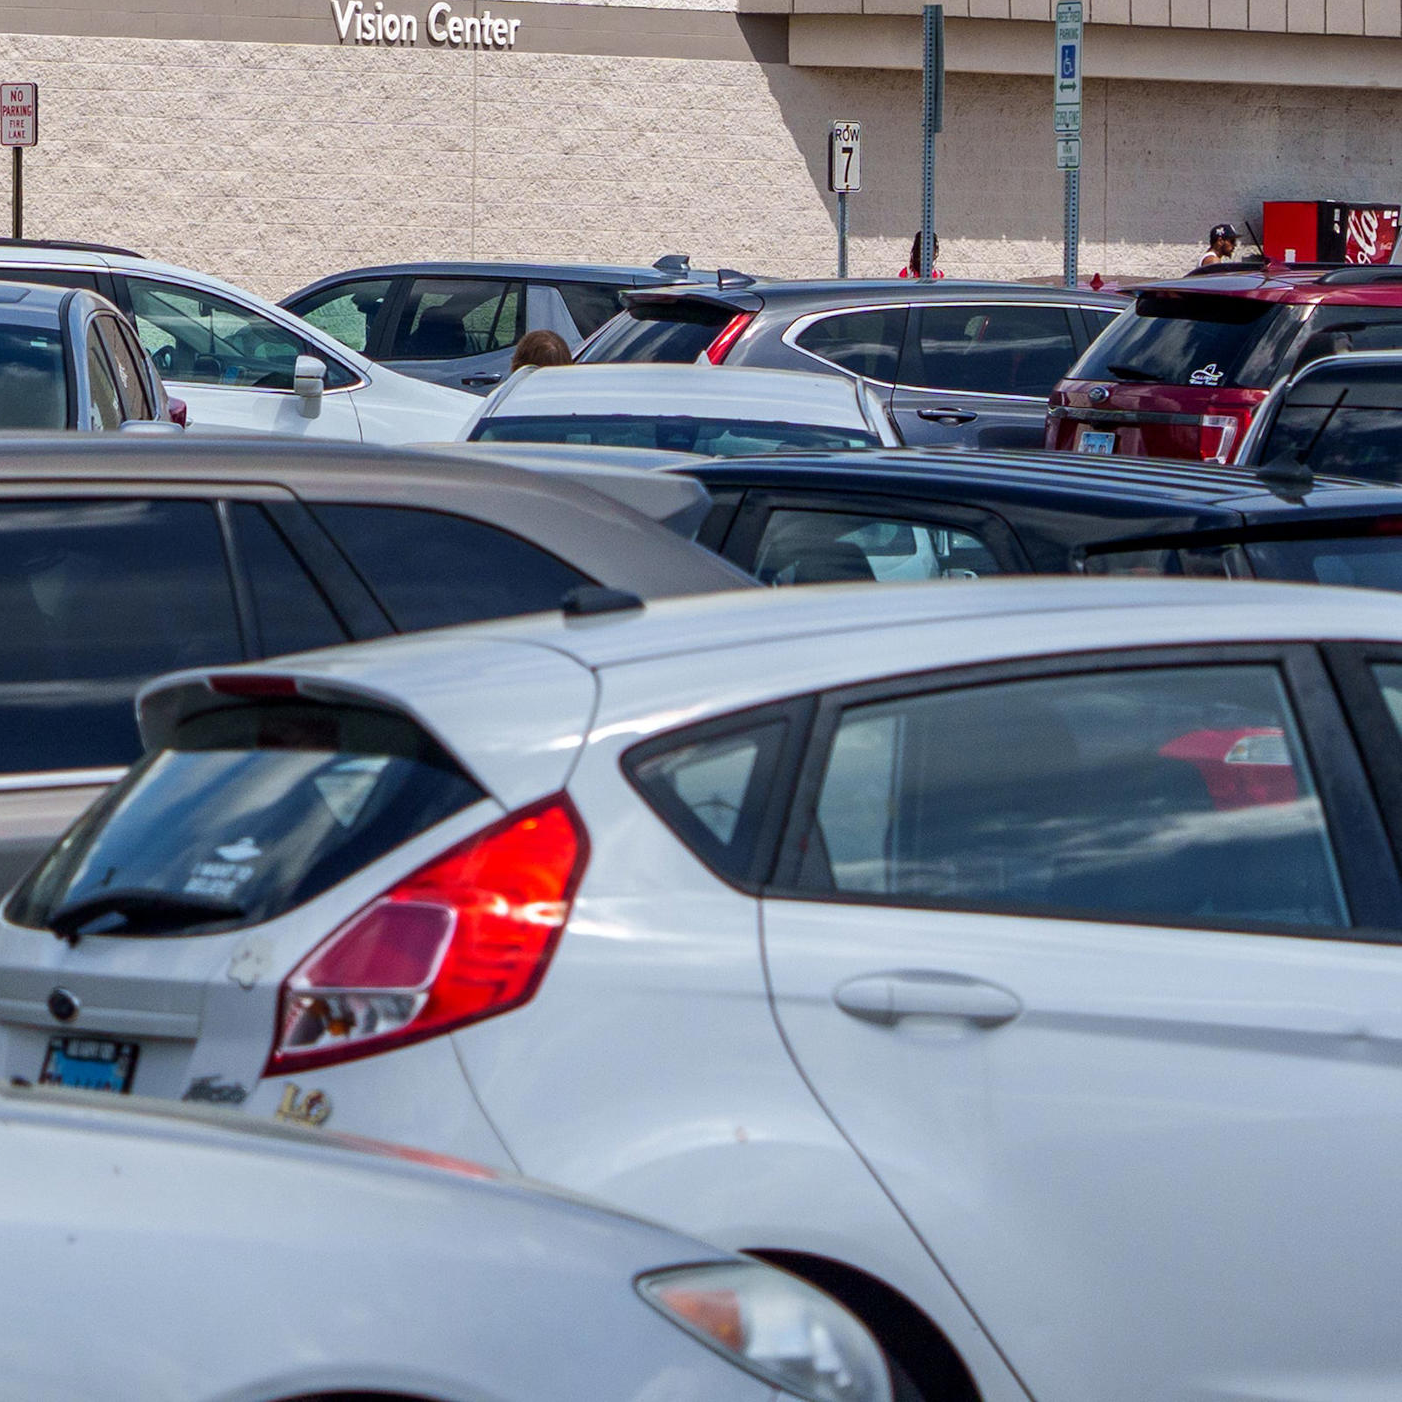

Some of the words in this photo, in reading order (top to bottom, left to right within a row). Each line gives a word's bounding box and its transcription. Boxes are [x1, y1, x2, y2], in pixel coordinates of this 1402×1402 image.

[330, 0, 417, 41] Vision
[427, 1, 521, 46] Center
[10, 90, 24, 102] NO
[2, 105, 32, 116] PARKING
[9, 120, 25, 128] FIRE
[8, 131, 26, 139] LANE
[835, 128, 860, 141] ROW
[842, 147, 853, 183] 7
